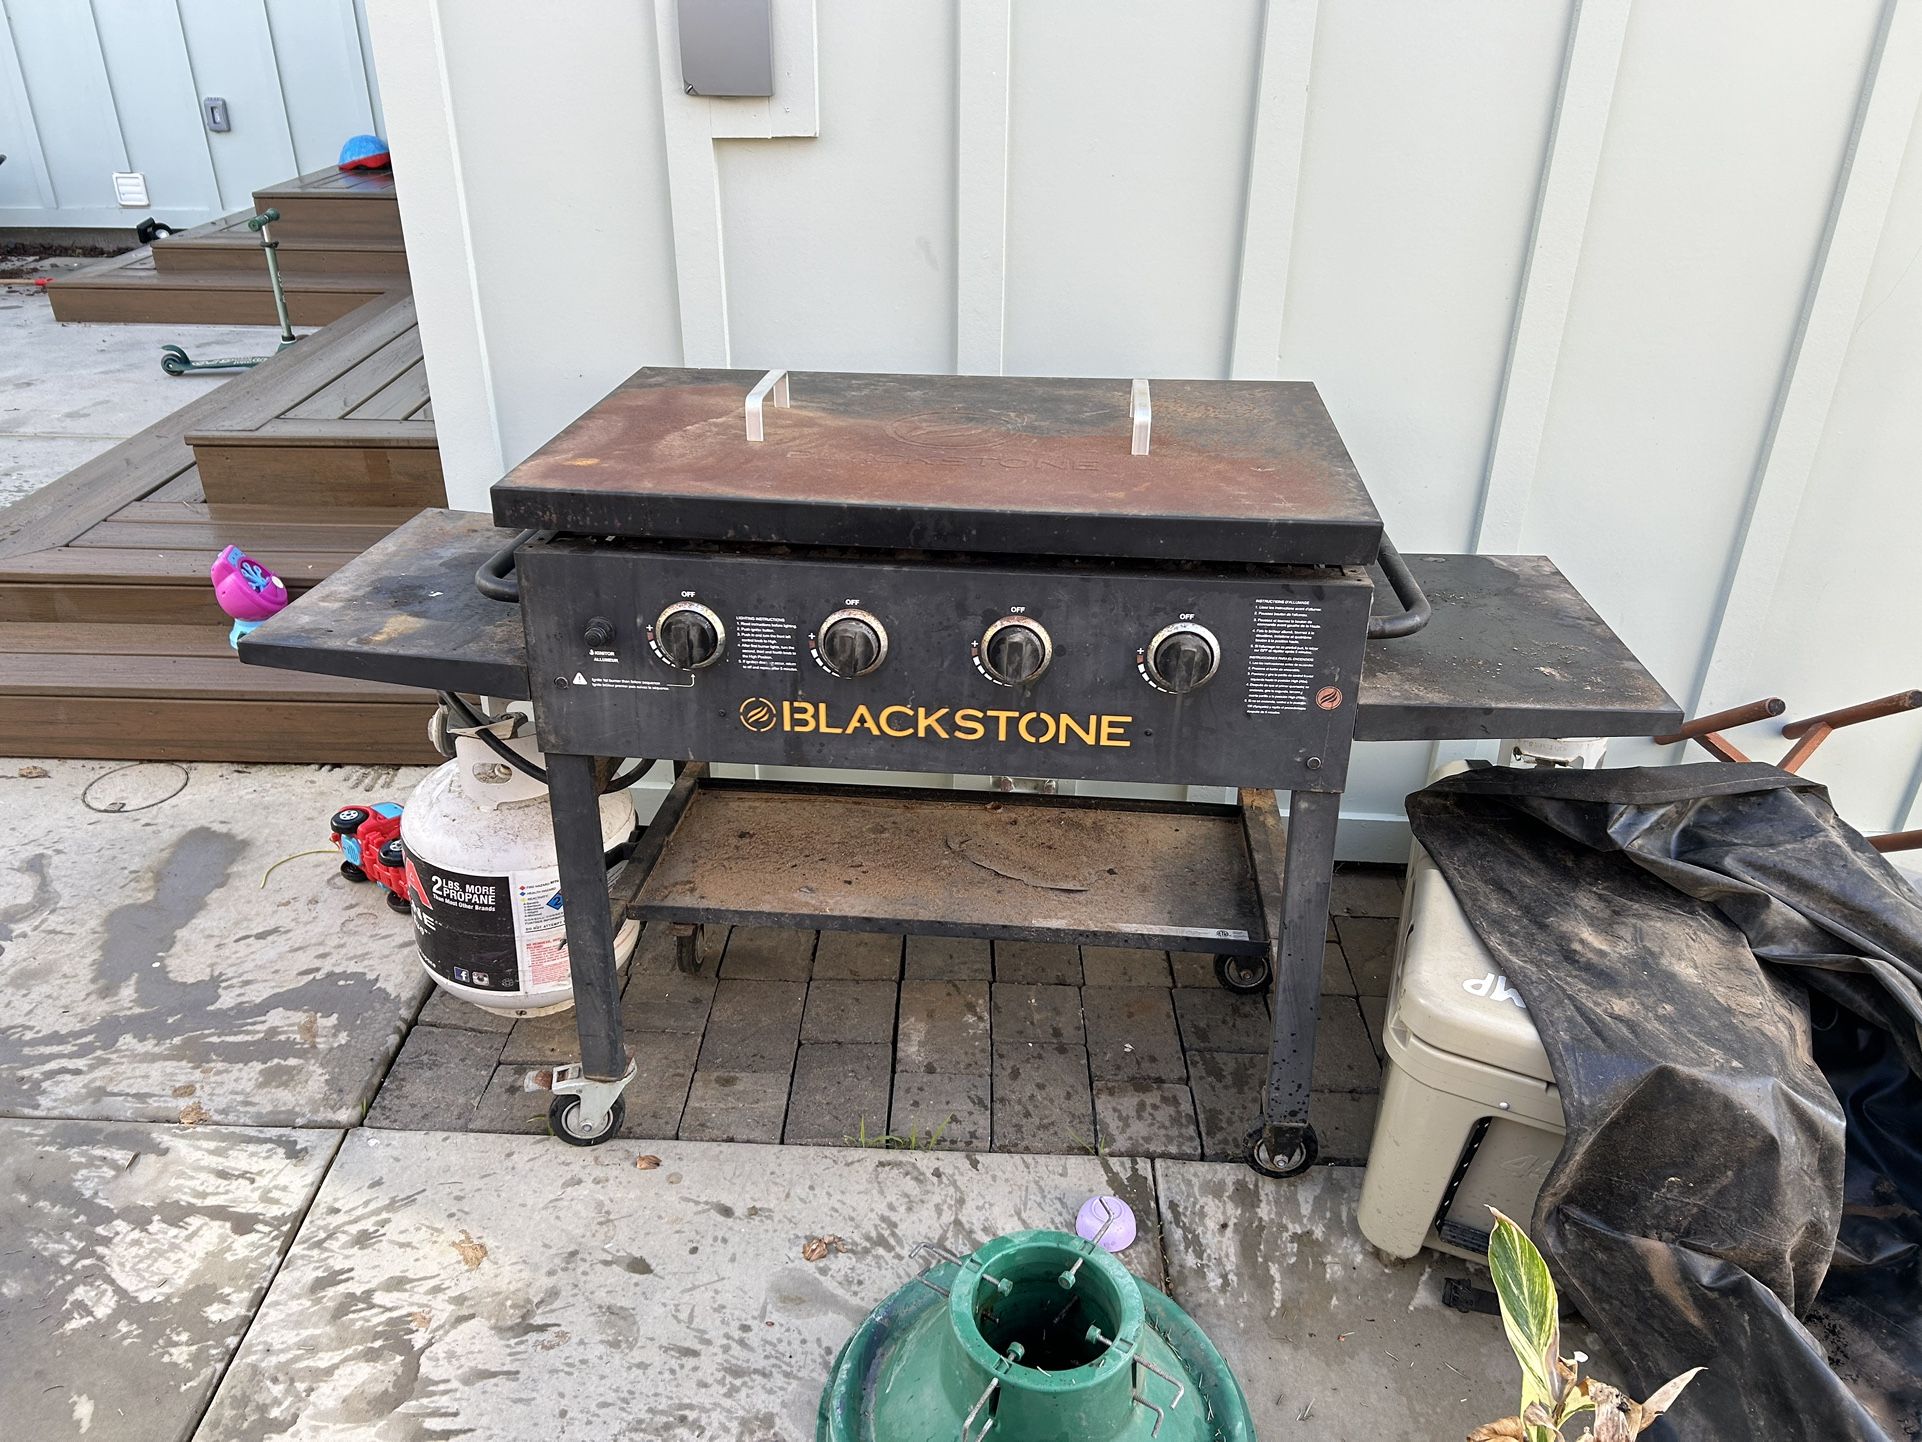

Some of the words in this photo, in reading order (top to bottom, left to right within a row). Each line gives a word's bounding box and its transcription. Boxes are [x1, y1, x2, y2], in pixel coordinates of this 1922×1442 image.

[782, 700, 1132, 747] BLACKSTONE
[431, 875, 443, 895] 2
[443, 878, 462, 891] LBS.
[466, 884, 496, 895] MORE
[433, 893, 444, 902] Than
[445, 898, 457, 906] Most
[458, 902, 474, 910] Other
[443, 888, 496, 905] PROPANE
[553, 896, 561, 906] 2
